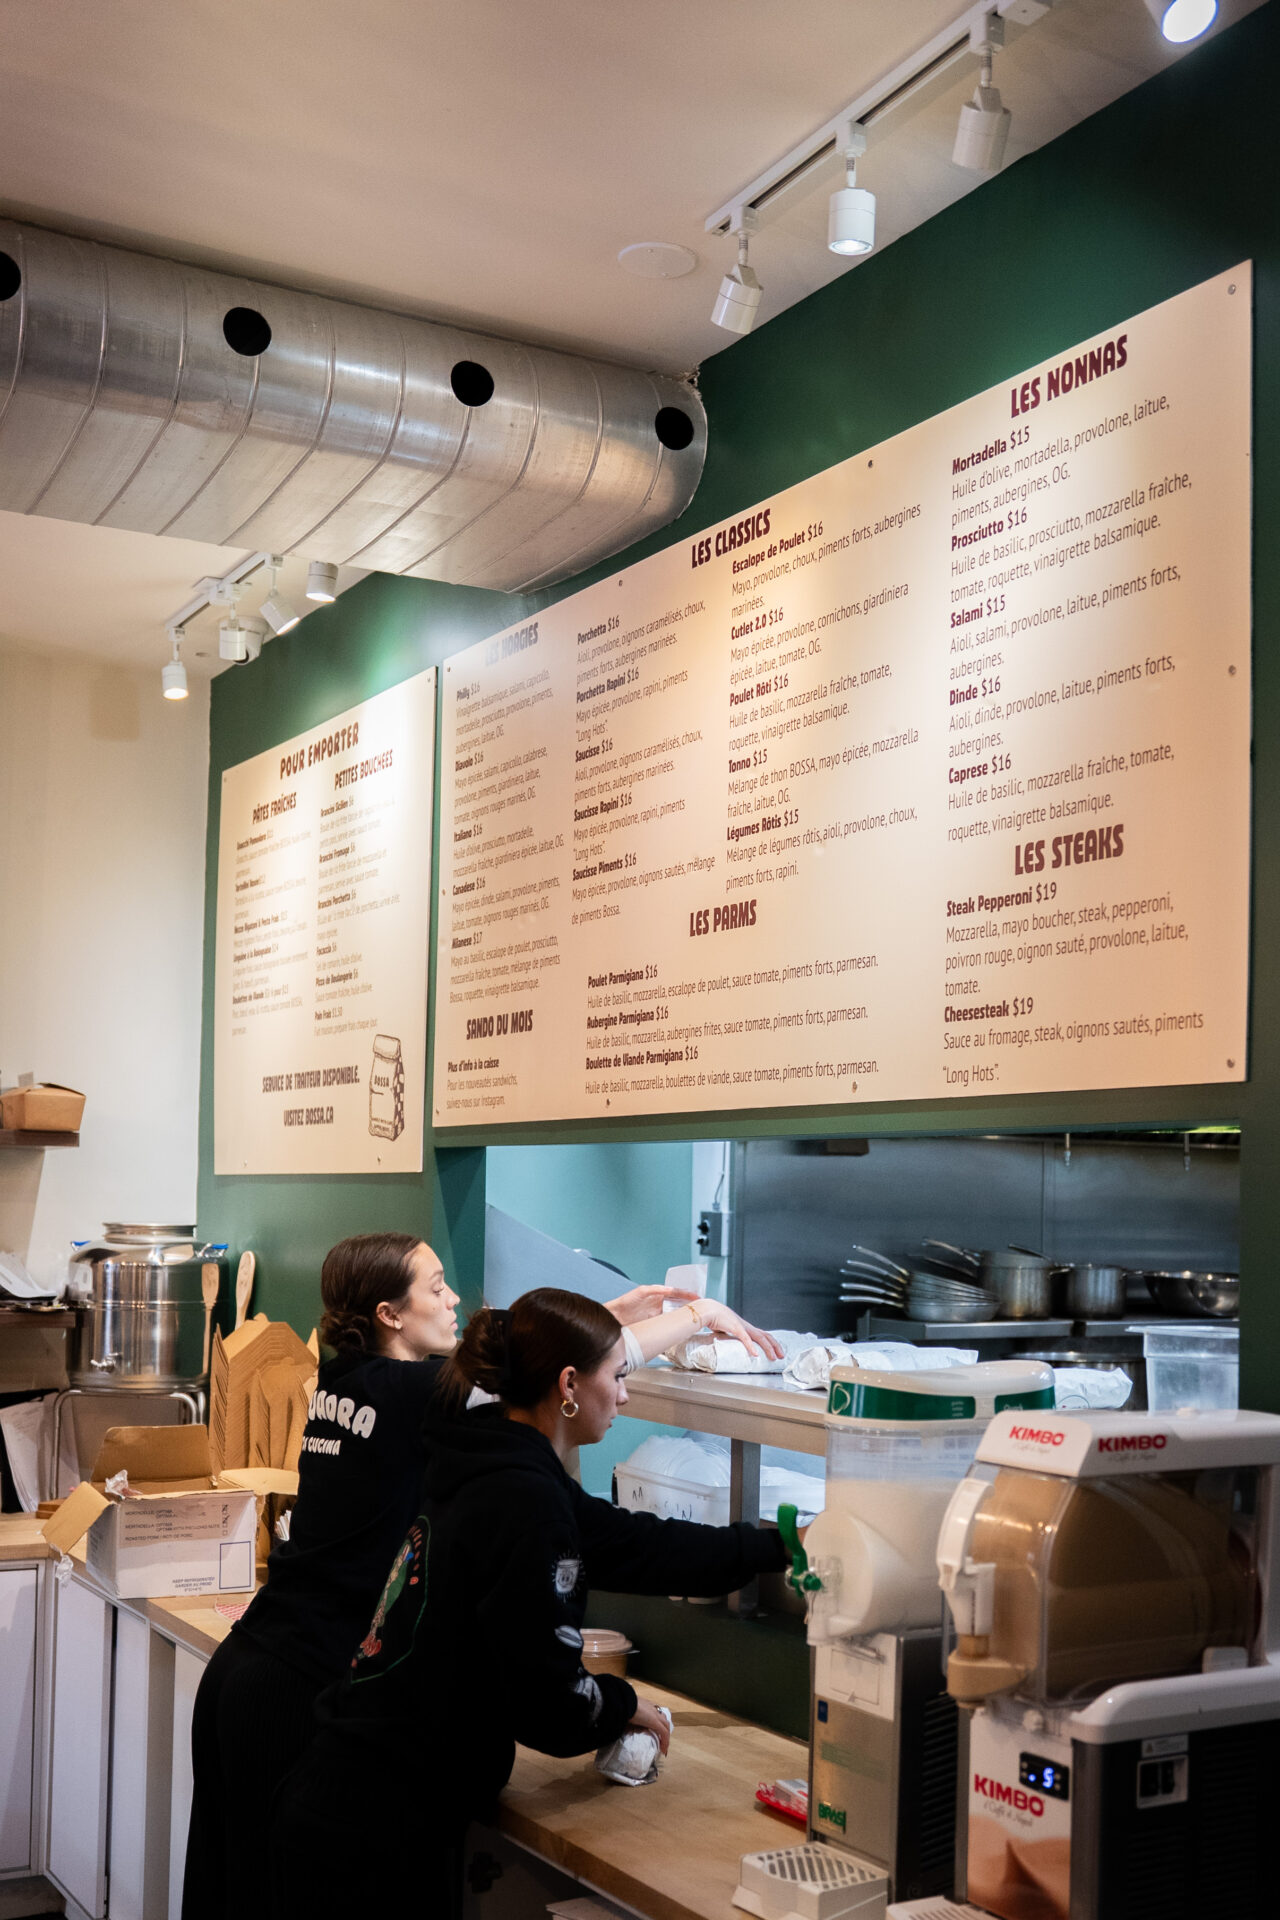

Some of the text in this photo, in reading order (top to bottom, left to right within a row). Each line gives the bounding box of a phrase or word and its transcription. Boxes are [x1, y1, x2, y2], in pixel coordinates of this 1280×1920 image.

[1011, 334, 1127, 418] LES NONNAS
[952, 478, 977, 500] Huile
[1014, 437, 1072, 473] mortadella,
[1074, 413, 1132, 452] provolone,
[1134, 396, 1170, 422] laitue,
[952, 425, 1030, 475] Mortadella $15
[952, 462, 1071, 530] piments, aubergines, OG.
[692, 508, 770, 569] LES CLASSICS
[951, 555, 976, 577] Huile
[978, 550, 990, 567] de
[993, 536, 1027, 561] basilic,
[1029, 516, 1083, 552] prosciutto,
[1086, 489, 1145, 525] mozzarella
[952, 507, 1027, 552] Prosciutto $16
[732, 521, 823, 575] Escalope de Poulet $16
[951, 515, 1161, 603] tomate, roquette, vinaigrette balsamique.
[731, 607, 784, 640] Cutlet 2.0 $16
[950, 566, 1181, 654] Aioli, salami, provolone, laitue, piments forts,
[951, 594, 1005, 629] Salami $15
[502, 620, 539, 661] HOAGIES
[577, 615, 620, 645] Porchetta $16
[950, 652, 1004, 681] aubergines.
[576, 666, 639, 704] Porchetta Rapini $16
[730, 687, 754, 707] Poulet
[774, 673, 789, 692] $16
[949, 655, 1175, 732] Aioli, dinde, provolone, laitue, piments forts,
[950, 676, 1001, 706] Dinde $16
[280, 722, 359, 780] POUR EMPORTER
[575, 738, 613, 763] Saucisse $16
[729, 748, 767, 774] Tonno $15
[949, 732, 1004, 759] aubergines.
[334, 764, 358, 791] PETITES
[949, 753, 1012, 785] Caprese $16
[949, 791, 973, 810] Huile
[976, 787, 988, 804] de
[991, 778, 1025, 801] basilic,
[1027, 764, 1084, 792] mozzarella
[1130, 744, 1174, 768] tomate,
[574, 792, 632, 822] Saucisse Rapini $16
[784, 809, 799, 828] $15
[948, 794, 1114, 843] roquette, vinaigrette balsamique.
[573, 852, 637, 881] Saucisse Piments $16
[1015, 824, 1124, 876] LES STEAKS
[947, 882, 1057, 917] Steak Pepperoni $19
[690, 899, 757, 937] LES PARMS
[946, 892, 1174, 944] Mozzarella, mayo boucher, steak, pepperoni,
[946, 952, 981, 974] poivron
[984, 949, 1016, 967] rouge,
[1017, 942, 1052, 964] oignon
[1089, 928, 1149, 955] provolone,
[1151, 923, 1189, 942] laitue,
[588, 964, 658, 989] Poulet Parmigiana $16
[945, 979, 981, 997] tomate.
[466, 1009, 533, 1040] SANDO DU MOIS
[587, 1006, 669, 1030] Aubergine Parmigiana $16
[944, 997, 1033, 1023] Cheesesteak $19
[944, 1032, 971, 1050] Sauce
[974, 1033, 986, 1047] au
[988, 1028, 1032, 1048] fromage,
[1034, 1022, 1064, 1042] steak,
[1066, 1021, 1110, 1043] oignons
[1155, 1012, 1204, 1037] piments
[586, 1045, 698, 1070] Boulette de Viande Parmigiana $16
[262, 1065, 360, 1094] SERVICE DE TRAITEUR DISPONIBLE.
[284, 1106, 334, 1127] VISITEZ BOSSA.CA
[308, 1436, 342, 1456] CUCINA
[1009, 1426, 1065, 1446] KIMBO
[1098, 1434, 1167, 1453] KIMBO
[974, 1773, 1044, 1817] KIMBO
